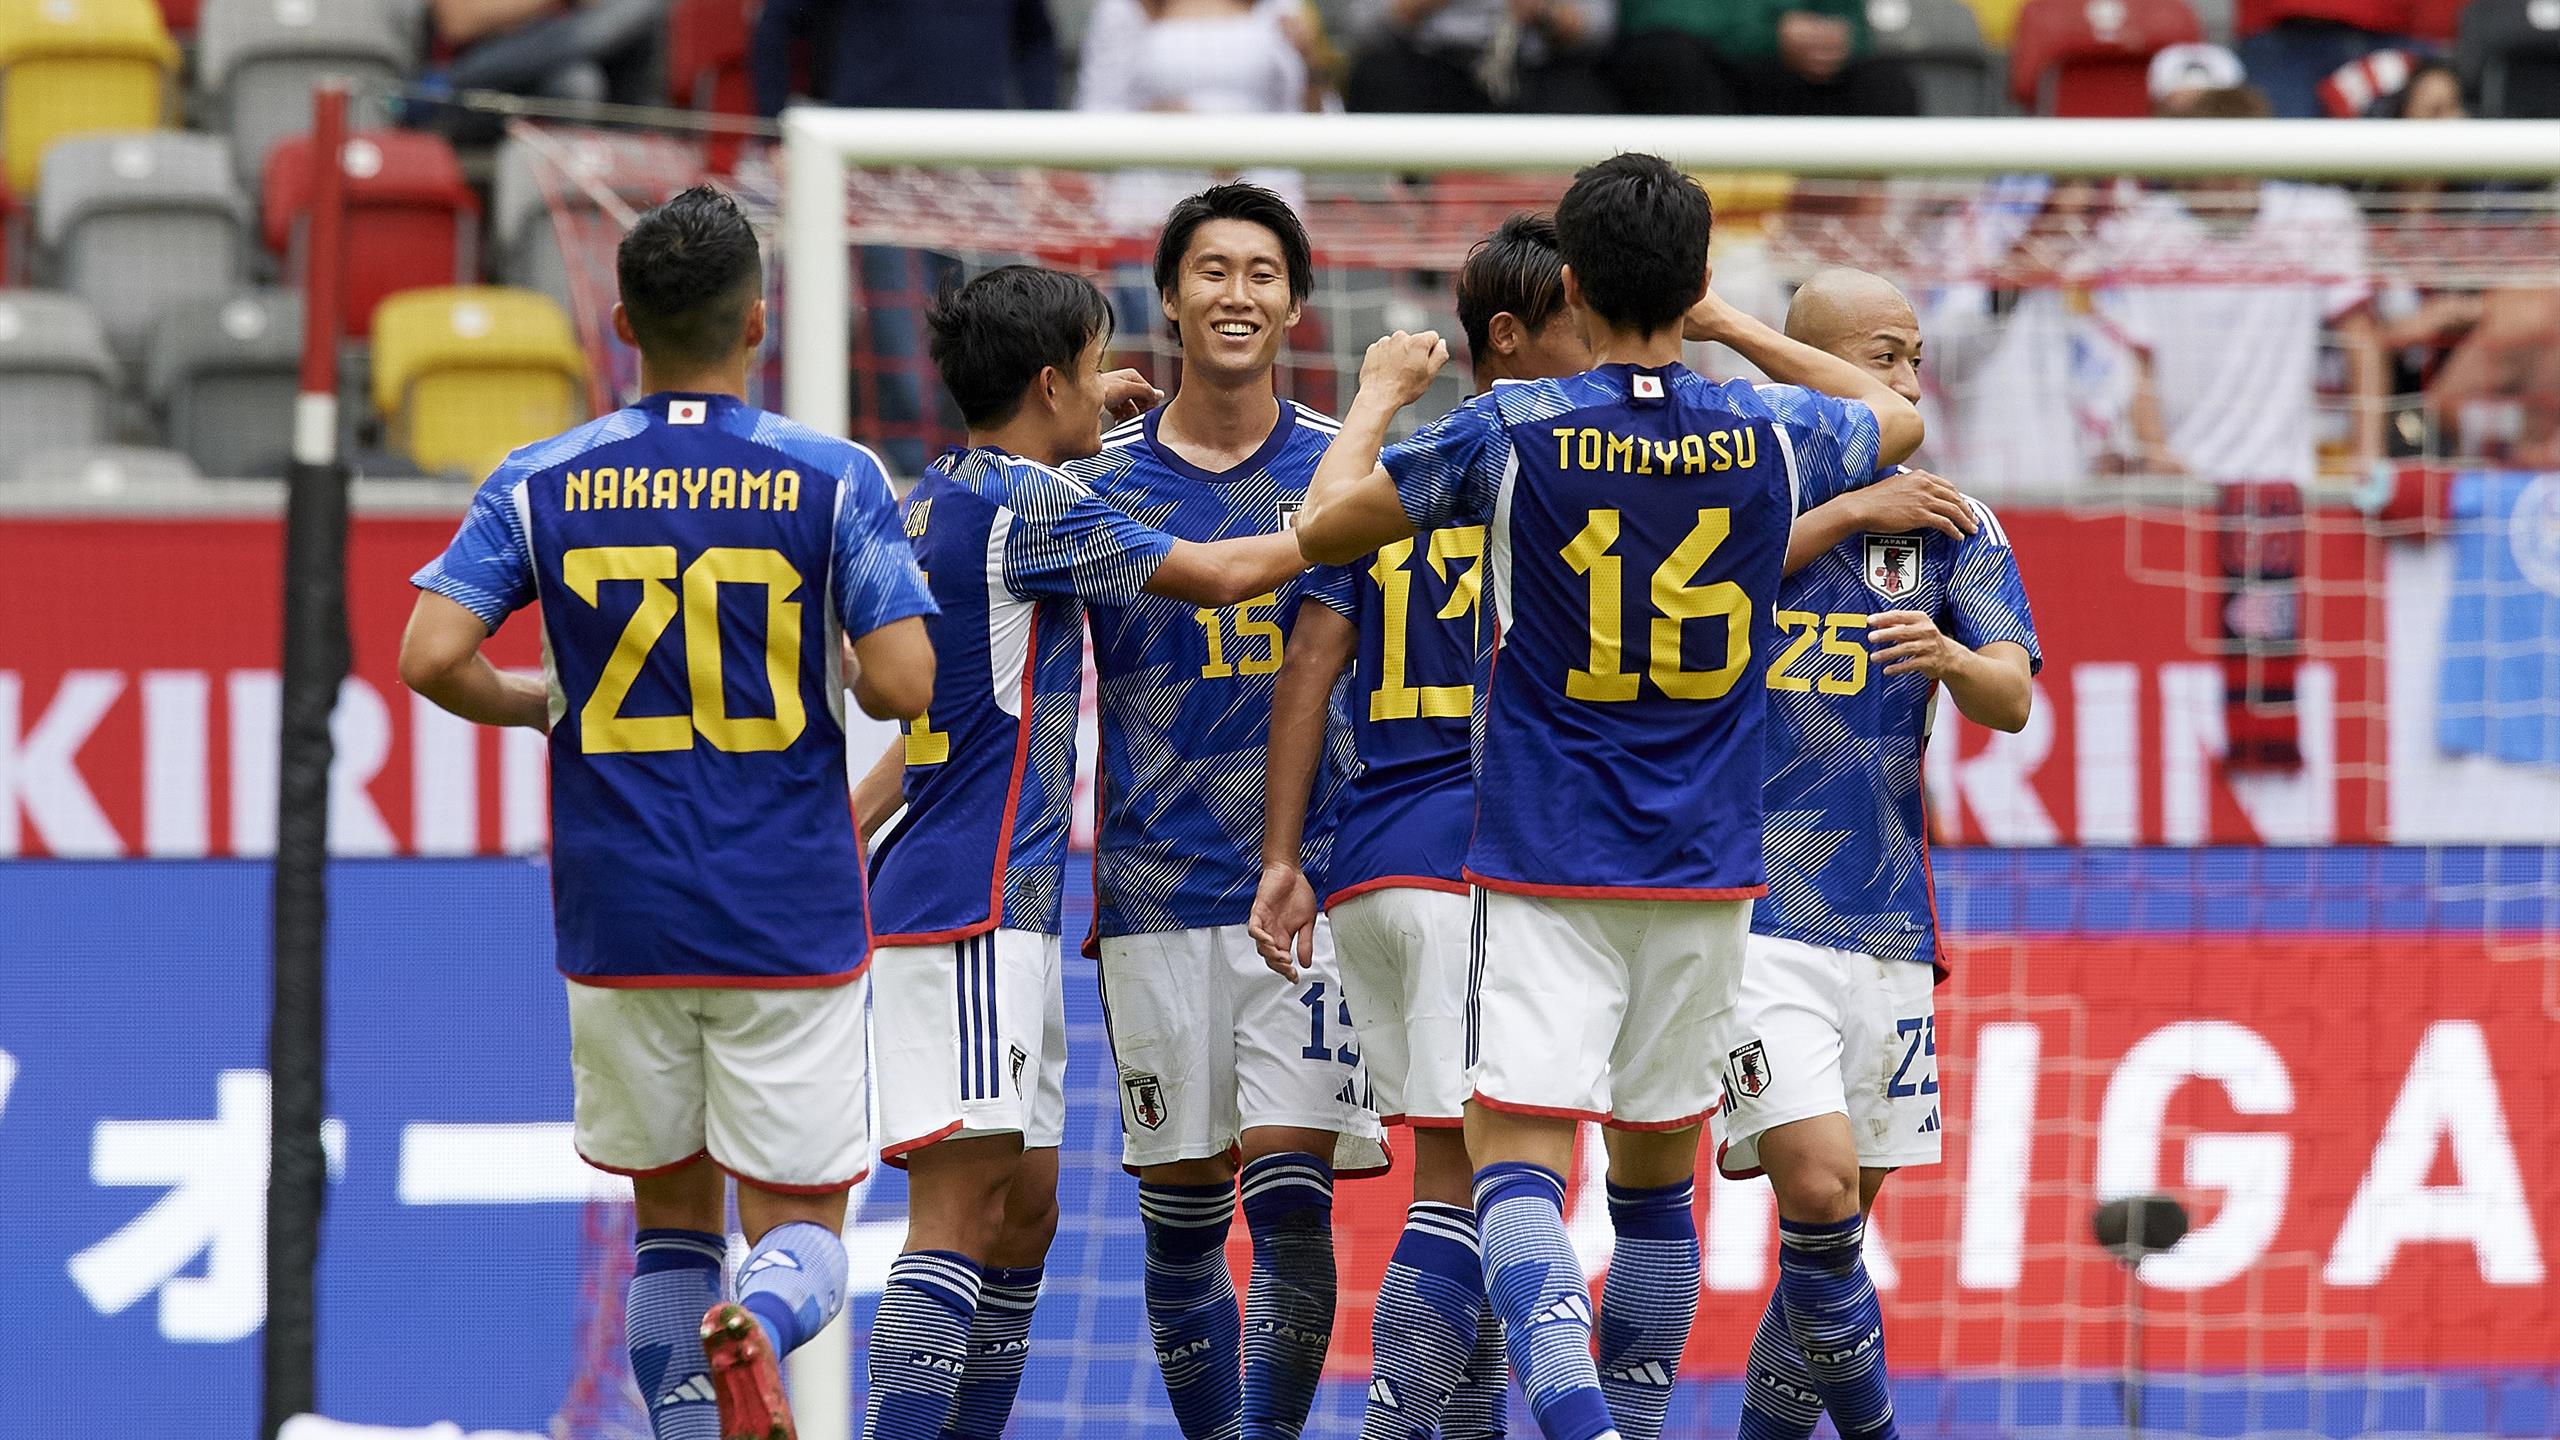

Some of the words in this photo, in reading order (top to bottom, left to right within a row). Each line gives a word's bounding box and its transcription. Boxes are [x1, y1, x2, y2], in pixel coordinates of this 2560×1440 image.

[564, 467, 801, 511] NAKAYAMA
[1553, 426, 1757, 475] TOMIYASU
[1194, 591, 1285, 679] 15
[1559, 507, 1752, 702] 16
[563, 545, 804, 754] 20
[1766, 610, 1869, 697] 25
[0, 669, 551, 858] KIRI
